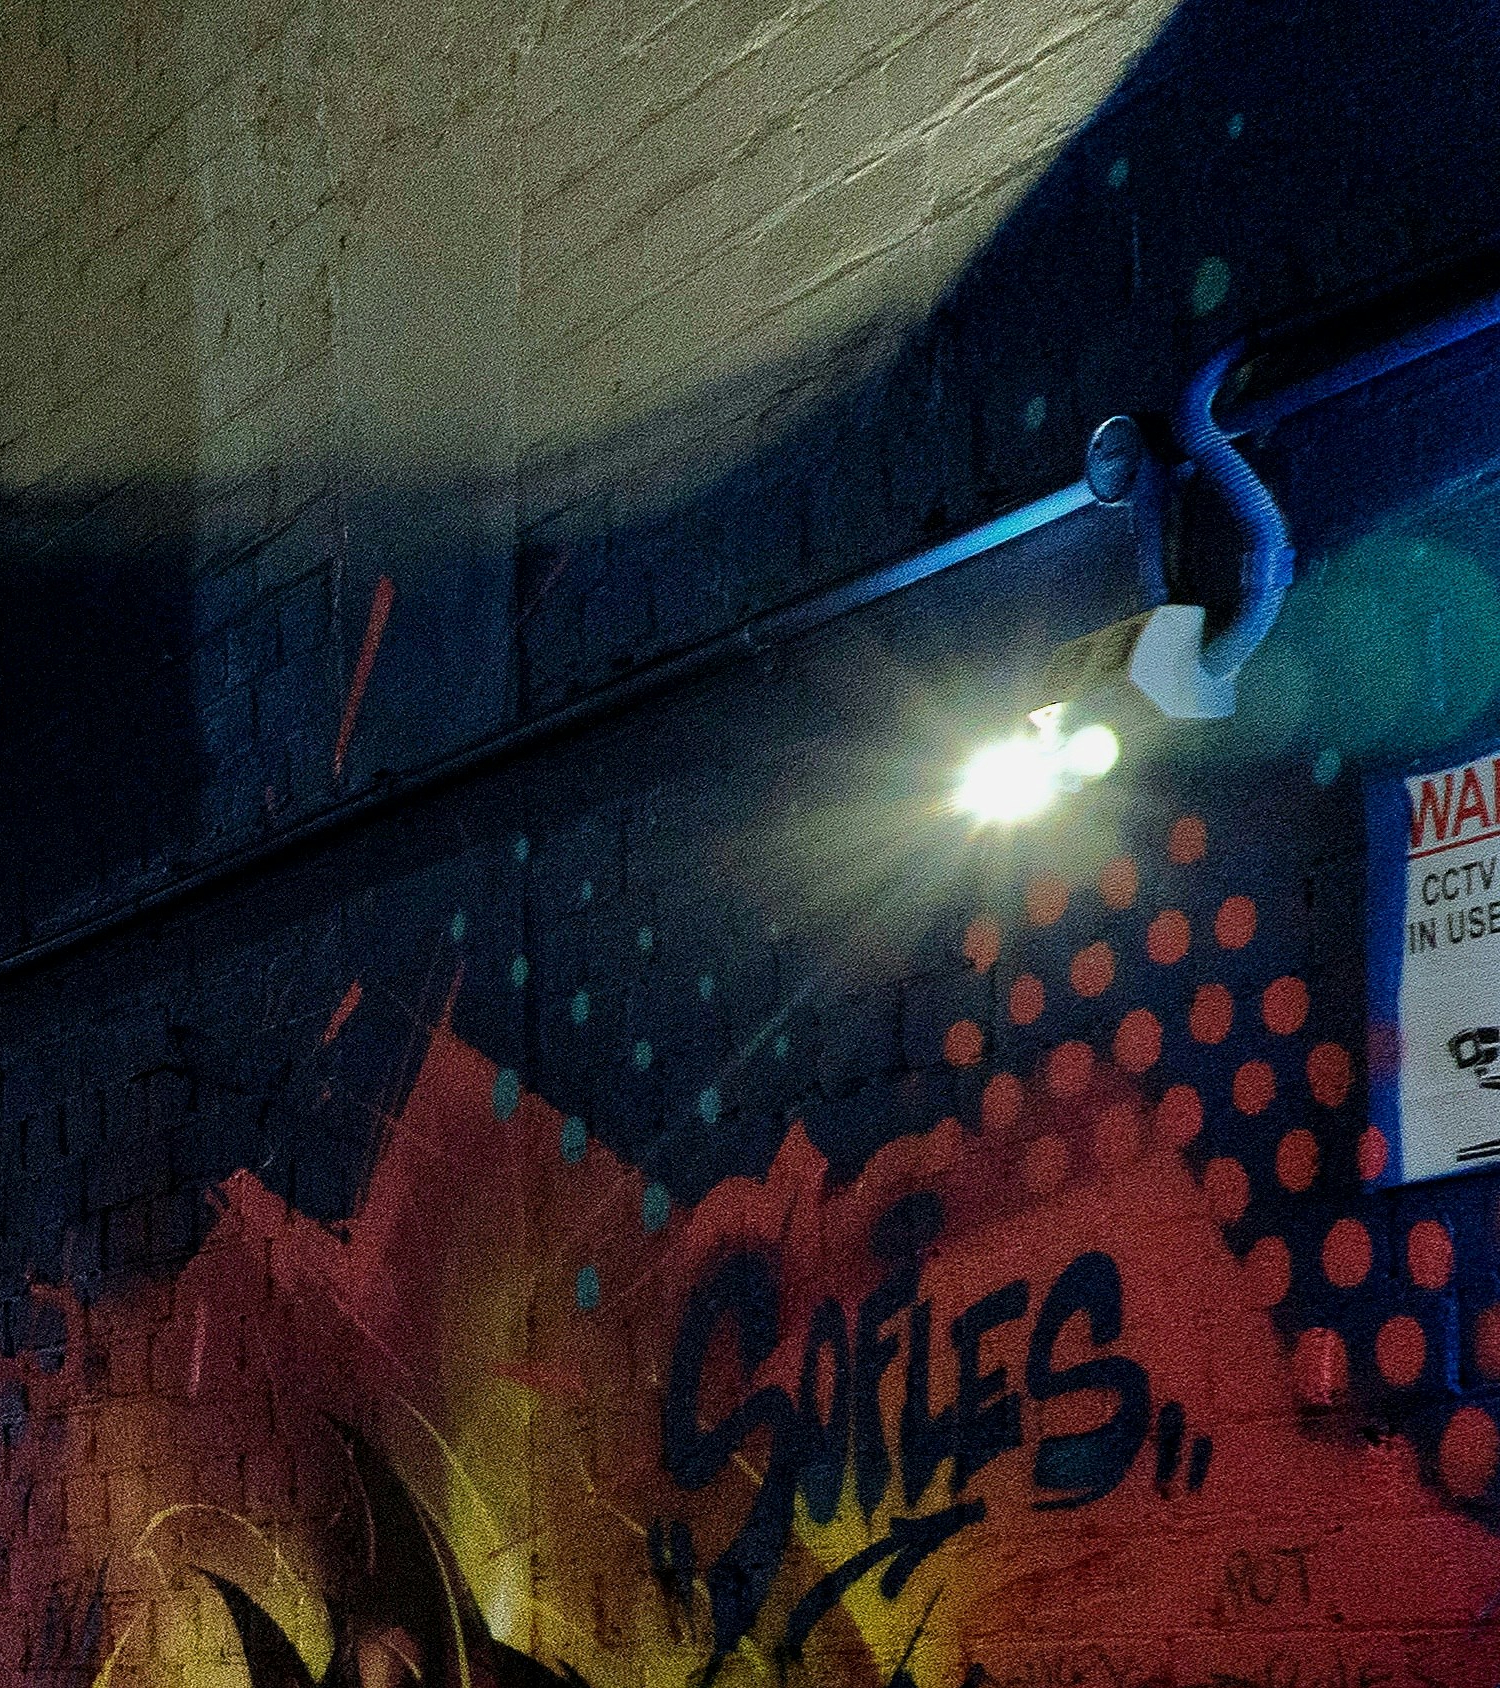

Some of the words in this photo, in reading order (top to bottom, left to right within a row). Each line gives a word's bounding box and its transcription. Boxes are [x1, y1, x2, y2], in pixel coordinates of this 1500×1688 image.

[1410, 758, 1500, 848] WA
[1422, 856, 1497, 907] CCTV
[1407, 915, 1438, 955] IN
